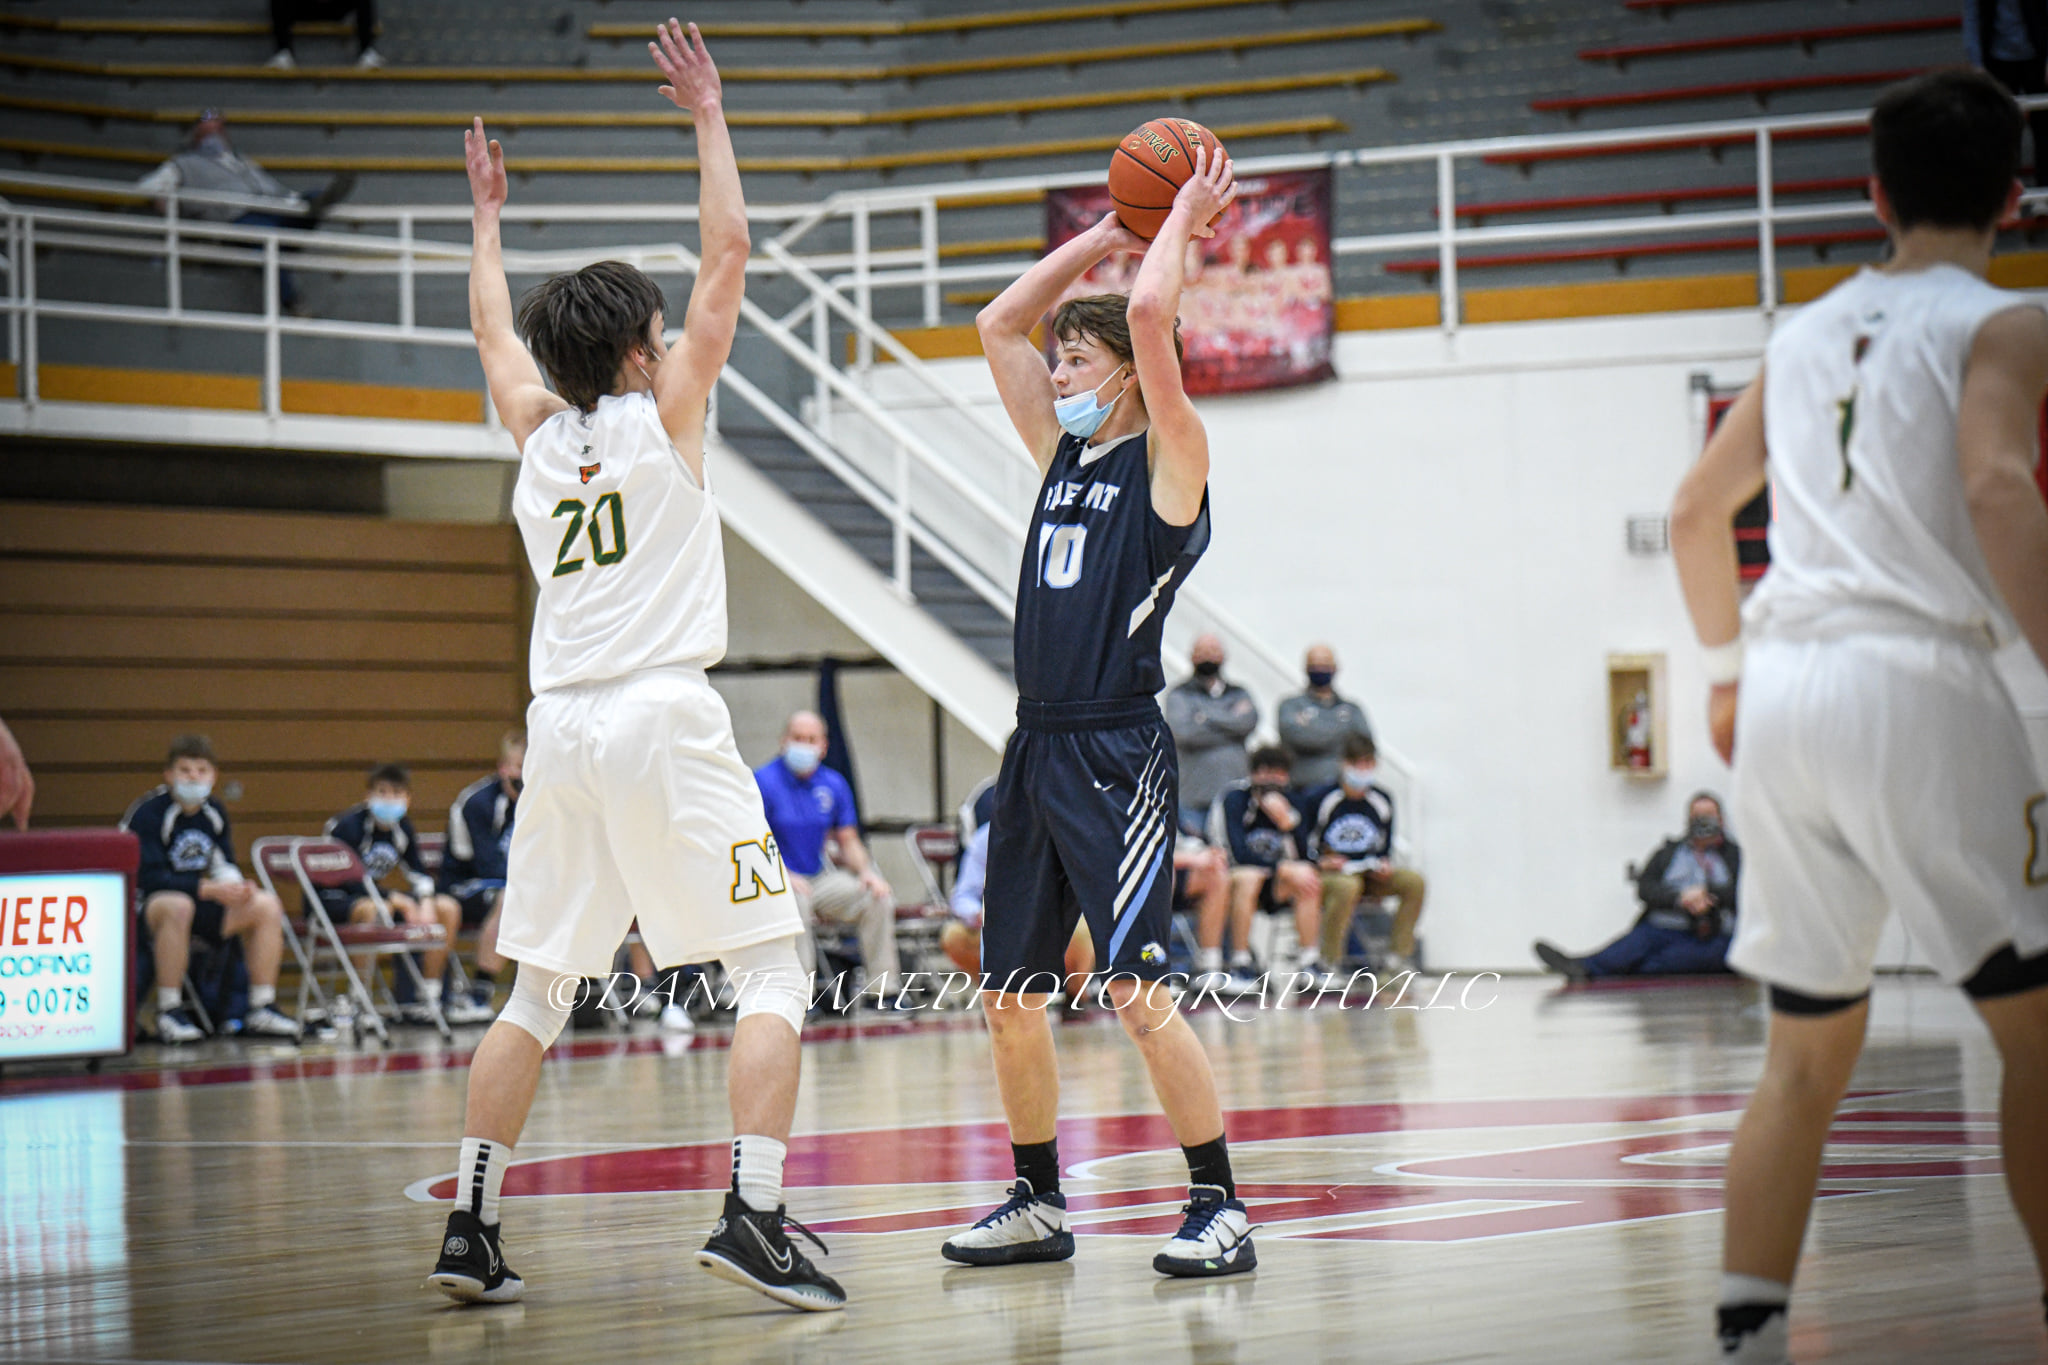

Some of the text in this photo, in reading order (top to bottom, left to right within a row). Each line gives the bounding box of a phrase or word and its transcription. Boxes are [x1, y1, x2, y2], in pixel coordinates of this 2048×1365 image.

[551, 490, 628, 578] 20
[1036, 521, 1088, 590] 10
[729, 832, 787, 905] N
